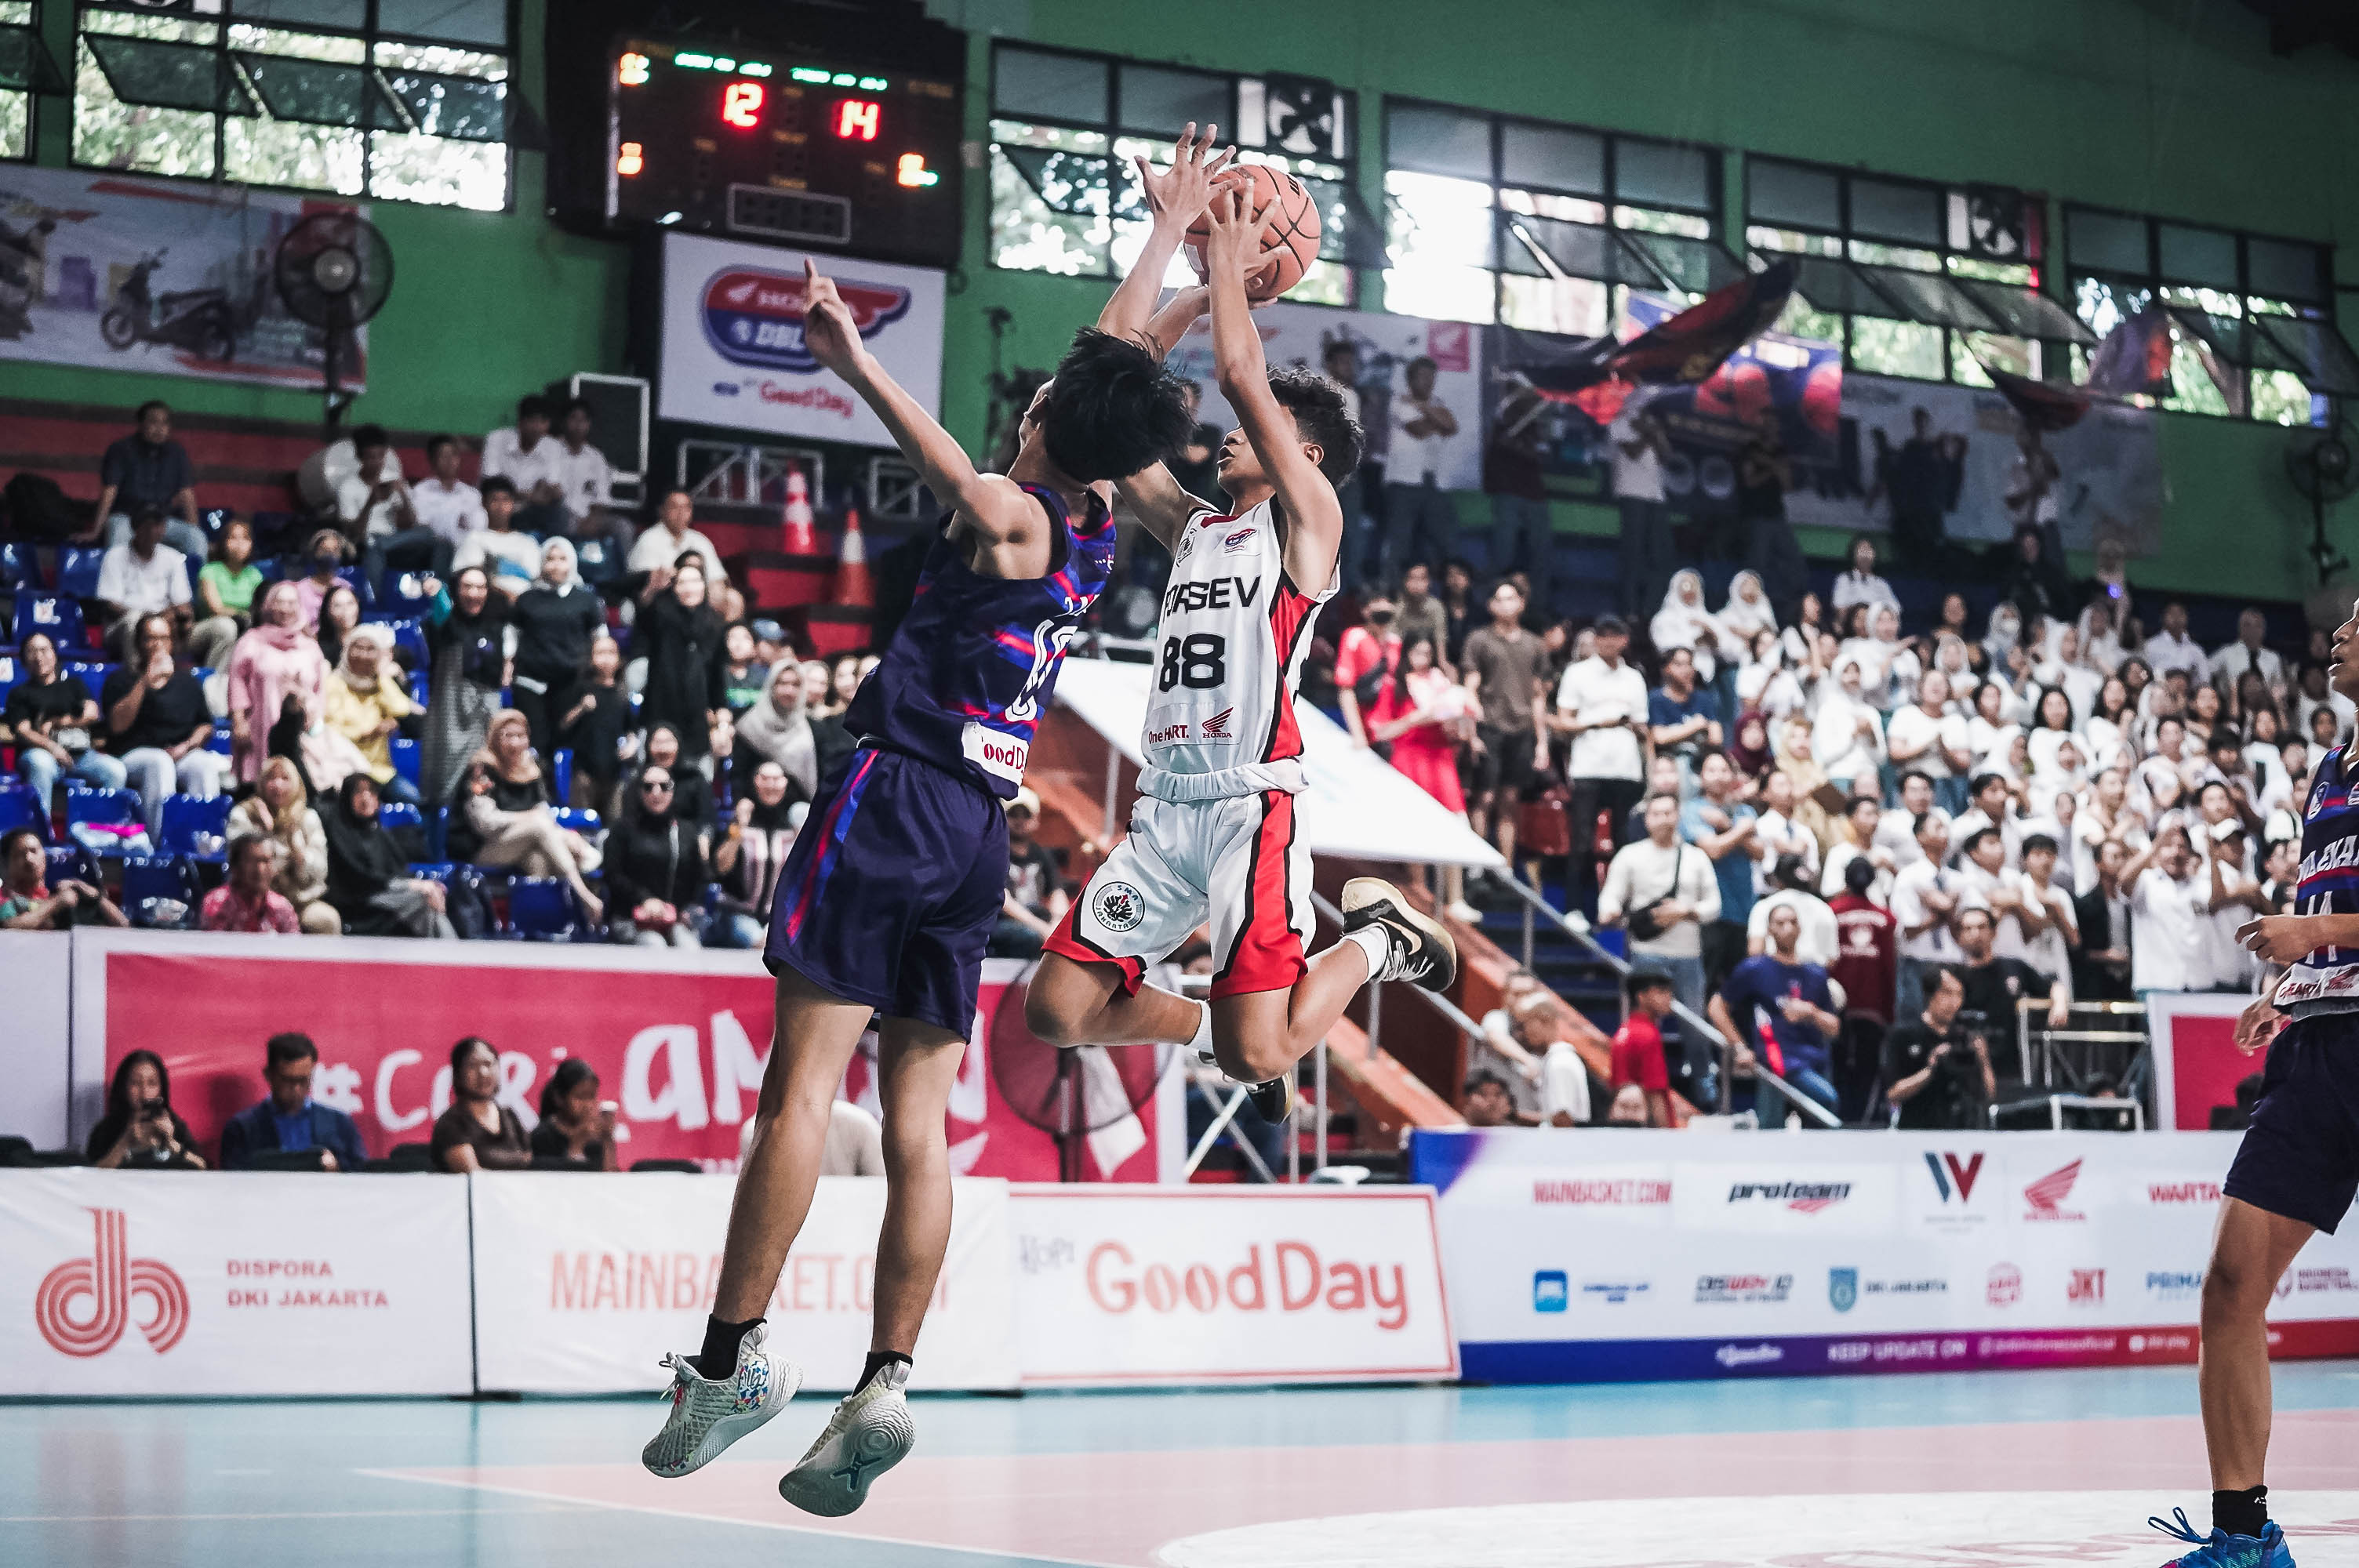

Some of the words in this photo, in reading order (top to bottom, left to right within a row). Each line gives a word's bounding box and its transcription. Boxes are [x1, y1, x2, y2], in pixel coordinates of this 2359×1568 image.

[724, 82, 764, 129] 12
[839, 100, 879, 141] 14
[1158, 633, 1226, 693] 88
[1117, 884, 1139, 901] SMA
[1728, 1181, 1852, 1202] proteam
[227, 1260, 333, 1277] DISPORA
[227, 1289, 269, 1307] DKI
[278, 1289, 389, 1308] JAKARTA
[1828, 1342, 1872, 1361] KEEP
[1874, 1340, 1936, 1360] UPDATE
[1940, 1339, 1967, 1358] ON
